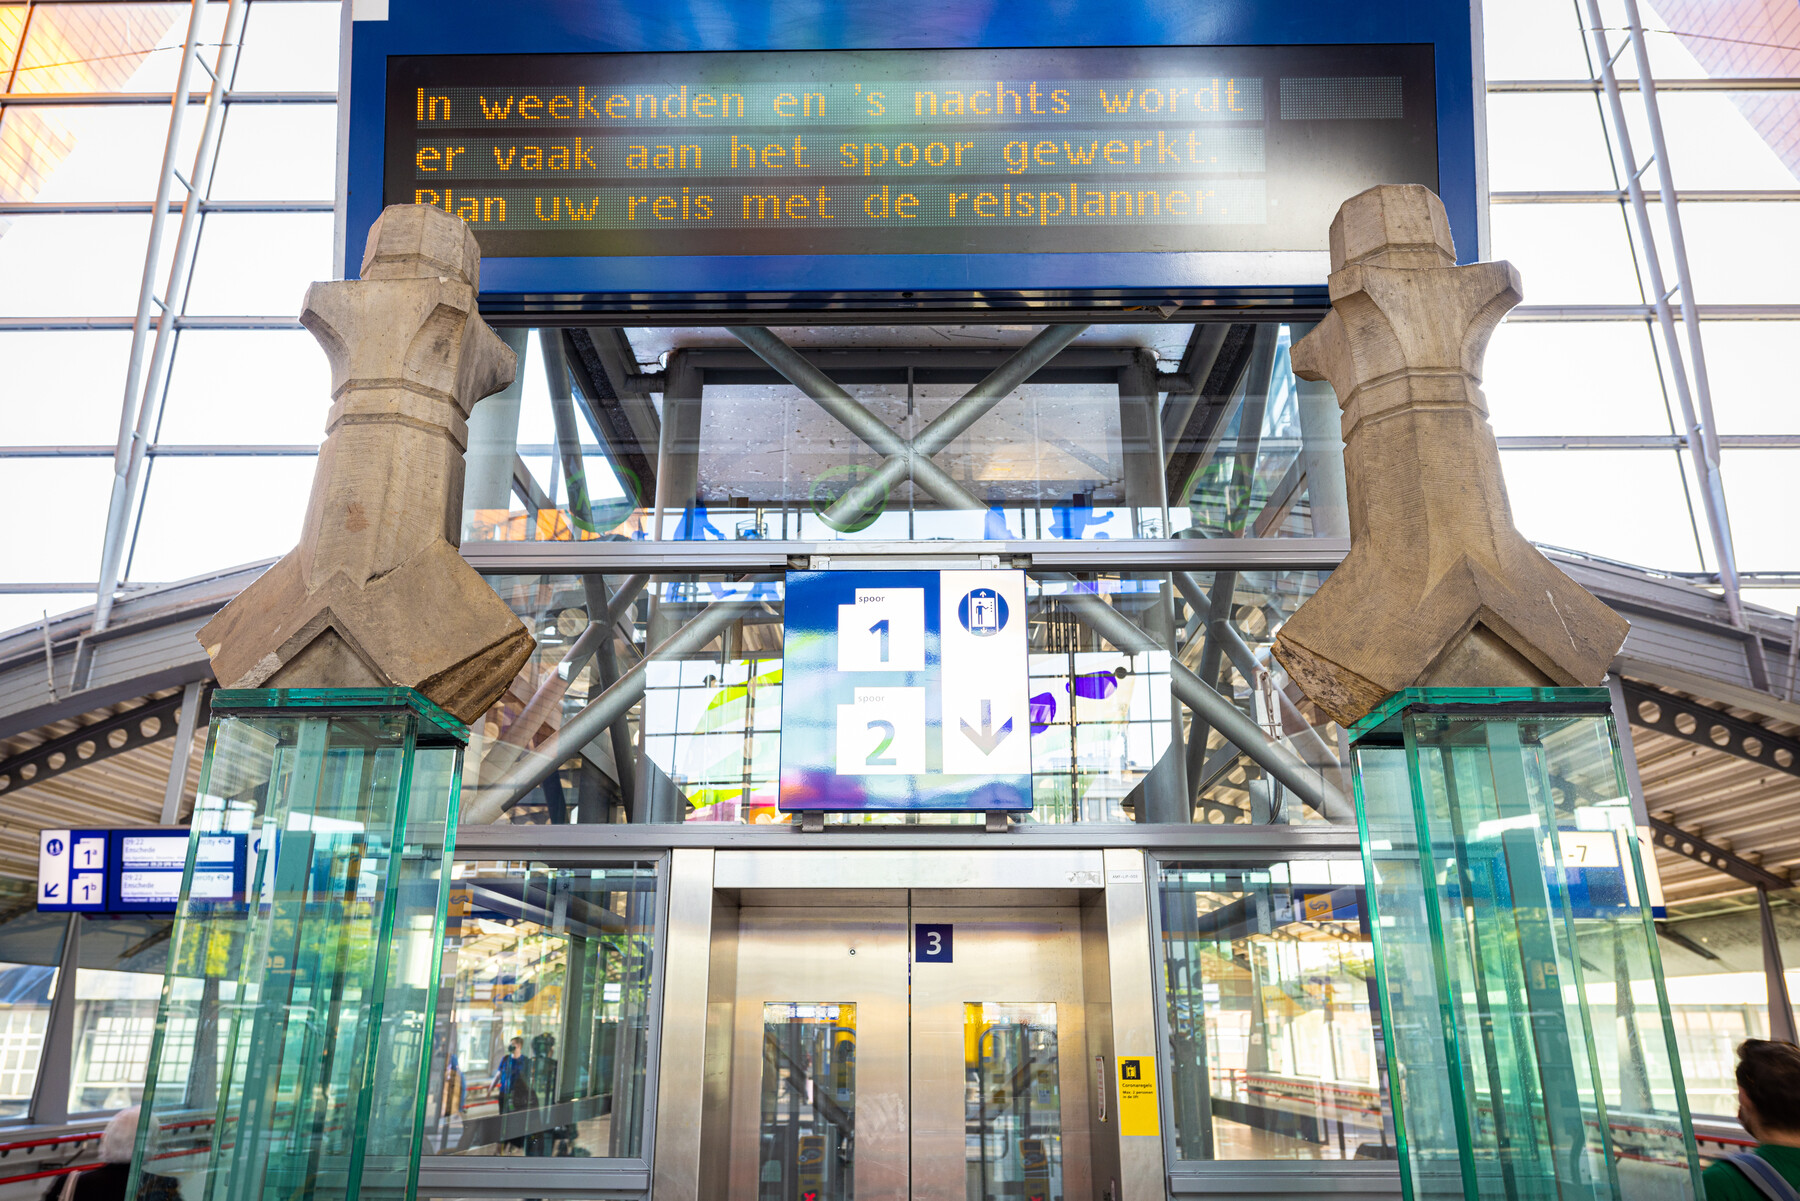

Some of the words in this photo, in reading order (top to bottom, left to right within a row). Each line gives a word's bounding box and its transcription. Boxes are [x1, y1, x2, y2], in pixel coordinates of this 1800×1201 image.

[416, 87, 452, 120] In
[480, 86, 744, 120] weekenden
[773, 92, 826, 117] en
[855, 83, 886, 117] 's
[914, 81, 1071, 116] nachts
[1099, 79, 1244, 114] wordt
[416, 146, 465, 171] er
[494, 137, 597, 171] vaak
[626, 145, 702, 170] aan
[731, 135, 811, 169] het
[839, 139, 974, 176] spoor
[1003, 130, 1218, 175] gewerkt.
[415, 189, 506, 222] Plan
[534, 196, 600, 221] uw
[628, 187, 714, 221] reis
[743, 186, 835, 220] met
[864, 185, 920, 219] de
[948, 183, 1228, 226] reisplanner.
[858, 595, 885, 604] spoor
[868, 619, 890, 662] 1
[858, 694, 885, 704] spoor
[865, 719, 897, 766] 2
[124, 846, 156, 854] Enschede
[123, 881, 155, 889] Enschede
[926, 931, 942, 955] 3
